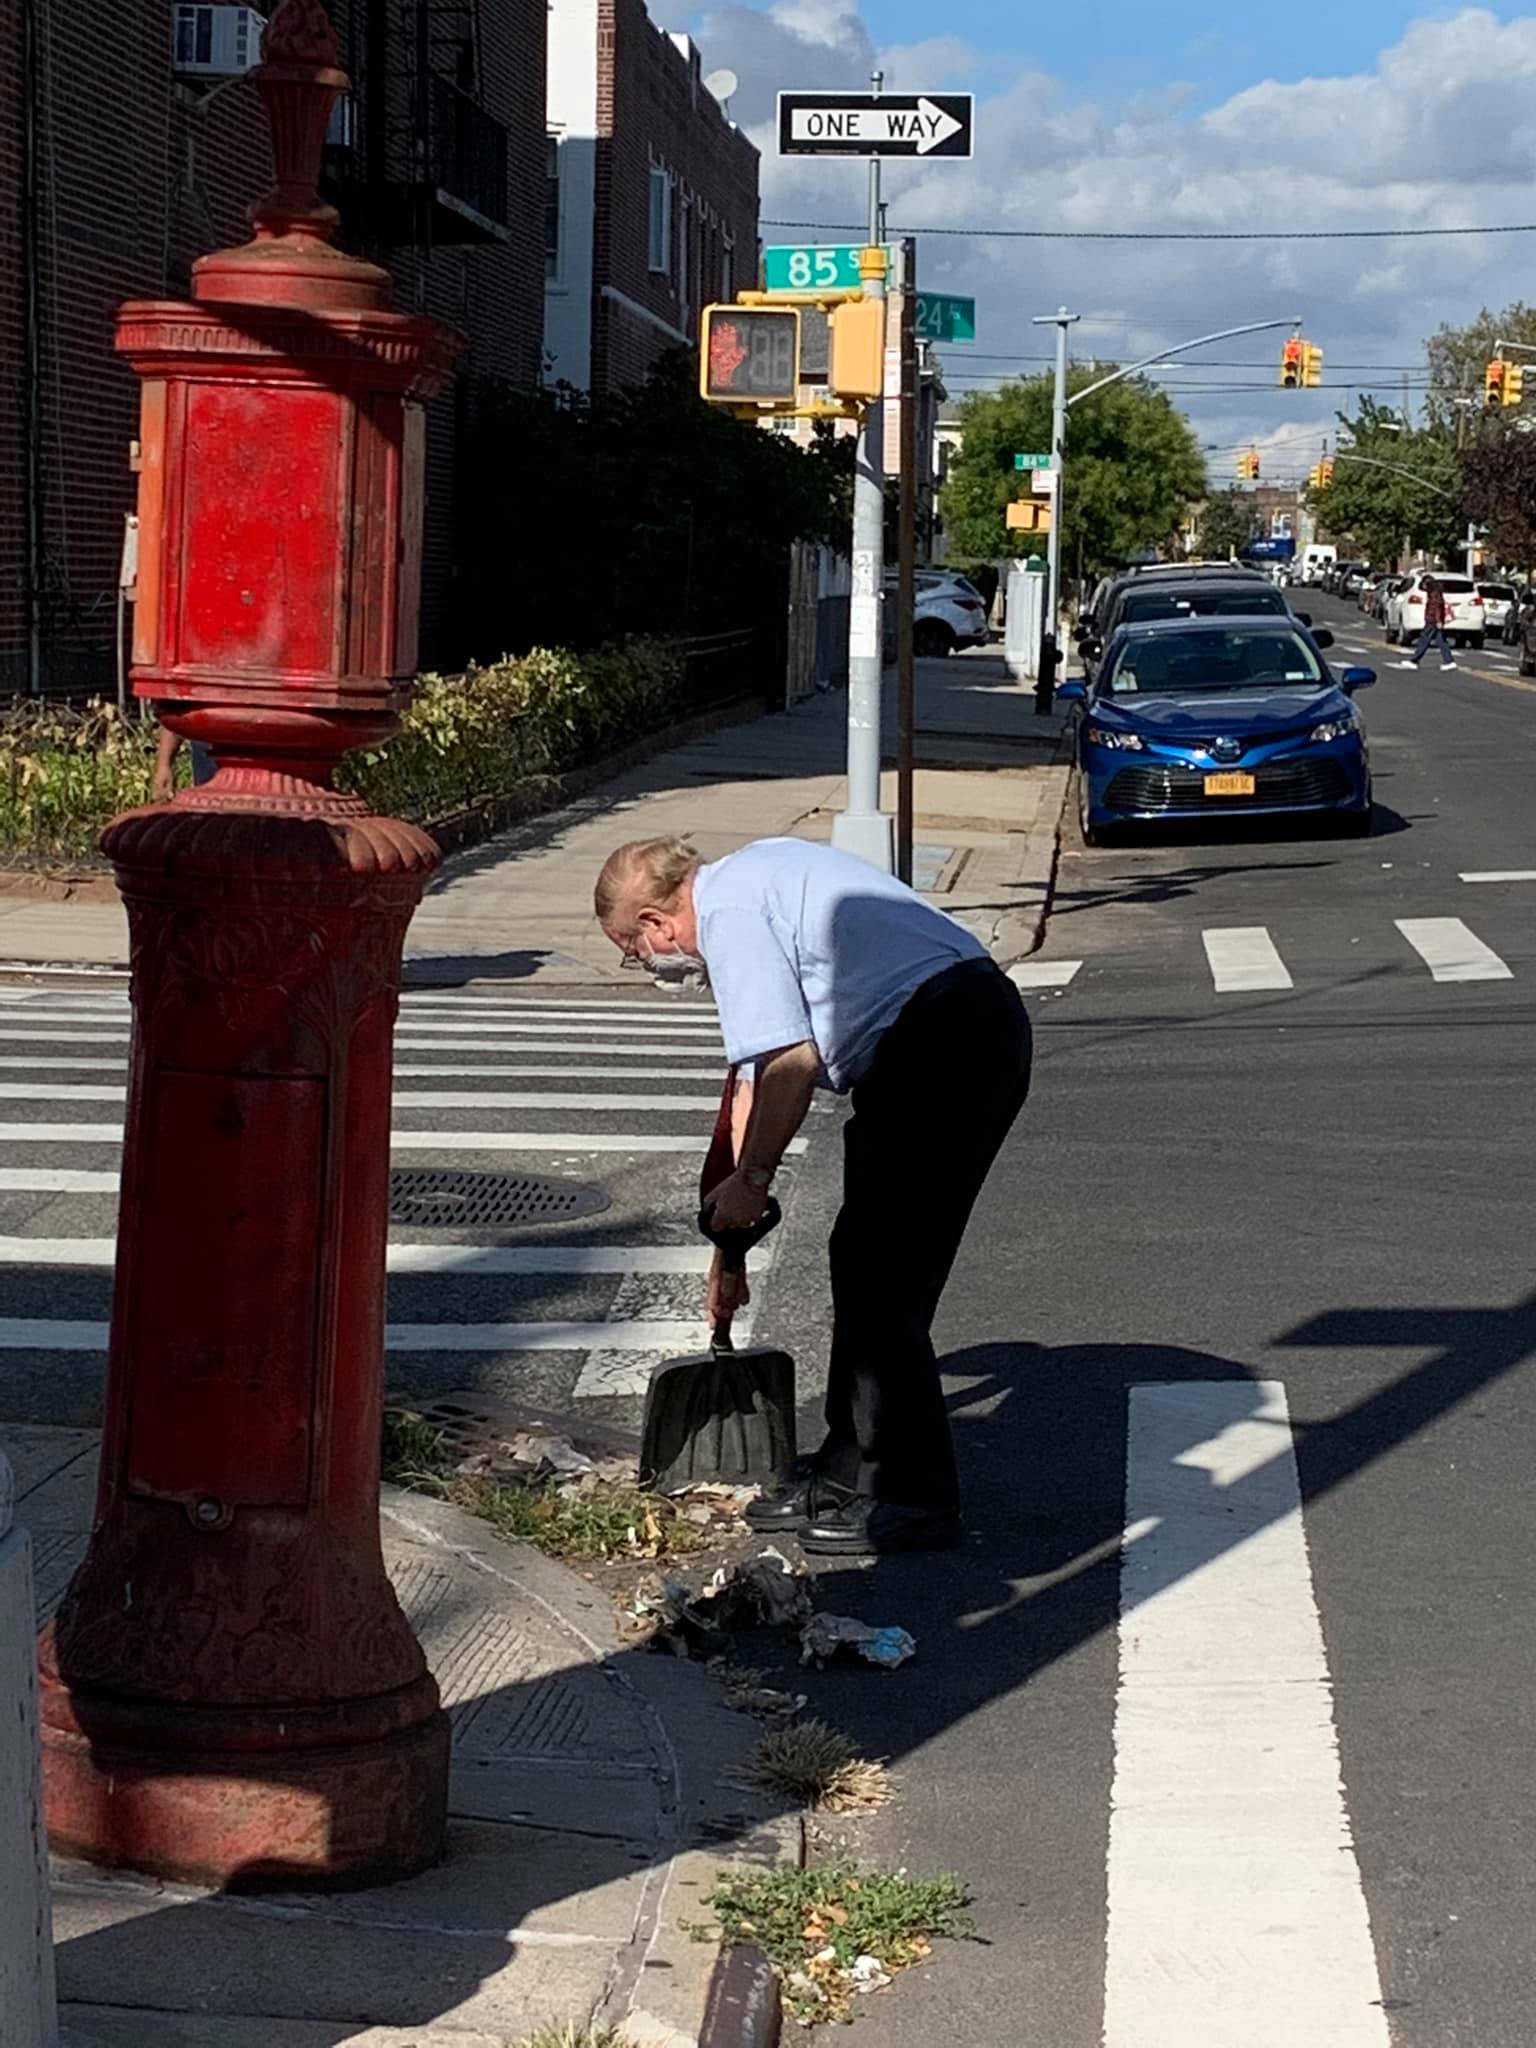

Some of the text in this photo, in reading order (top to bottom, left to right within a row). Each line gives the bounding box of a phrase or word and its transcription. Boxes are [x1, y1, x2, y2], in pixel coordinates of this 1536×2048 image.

[807, 113, 943, 138] ONE WAY
[788, 250, 861, 287] 85 S
[915, 298, 943, 335] 24
